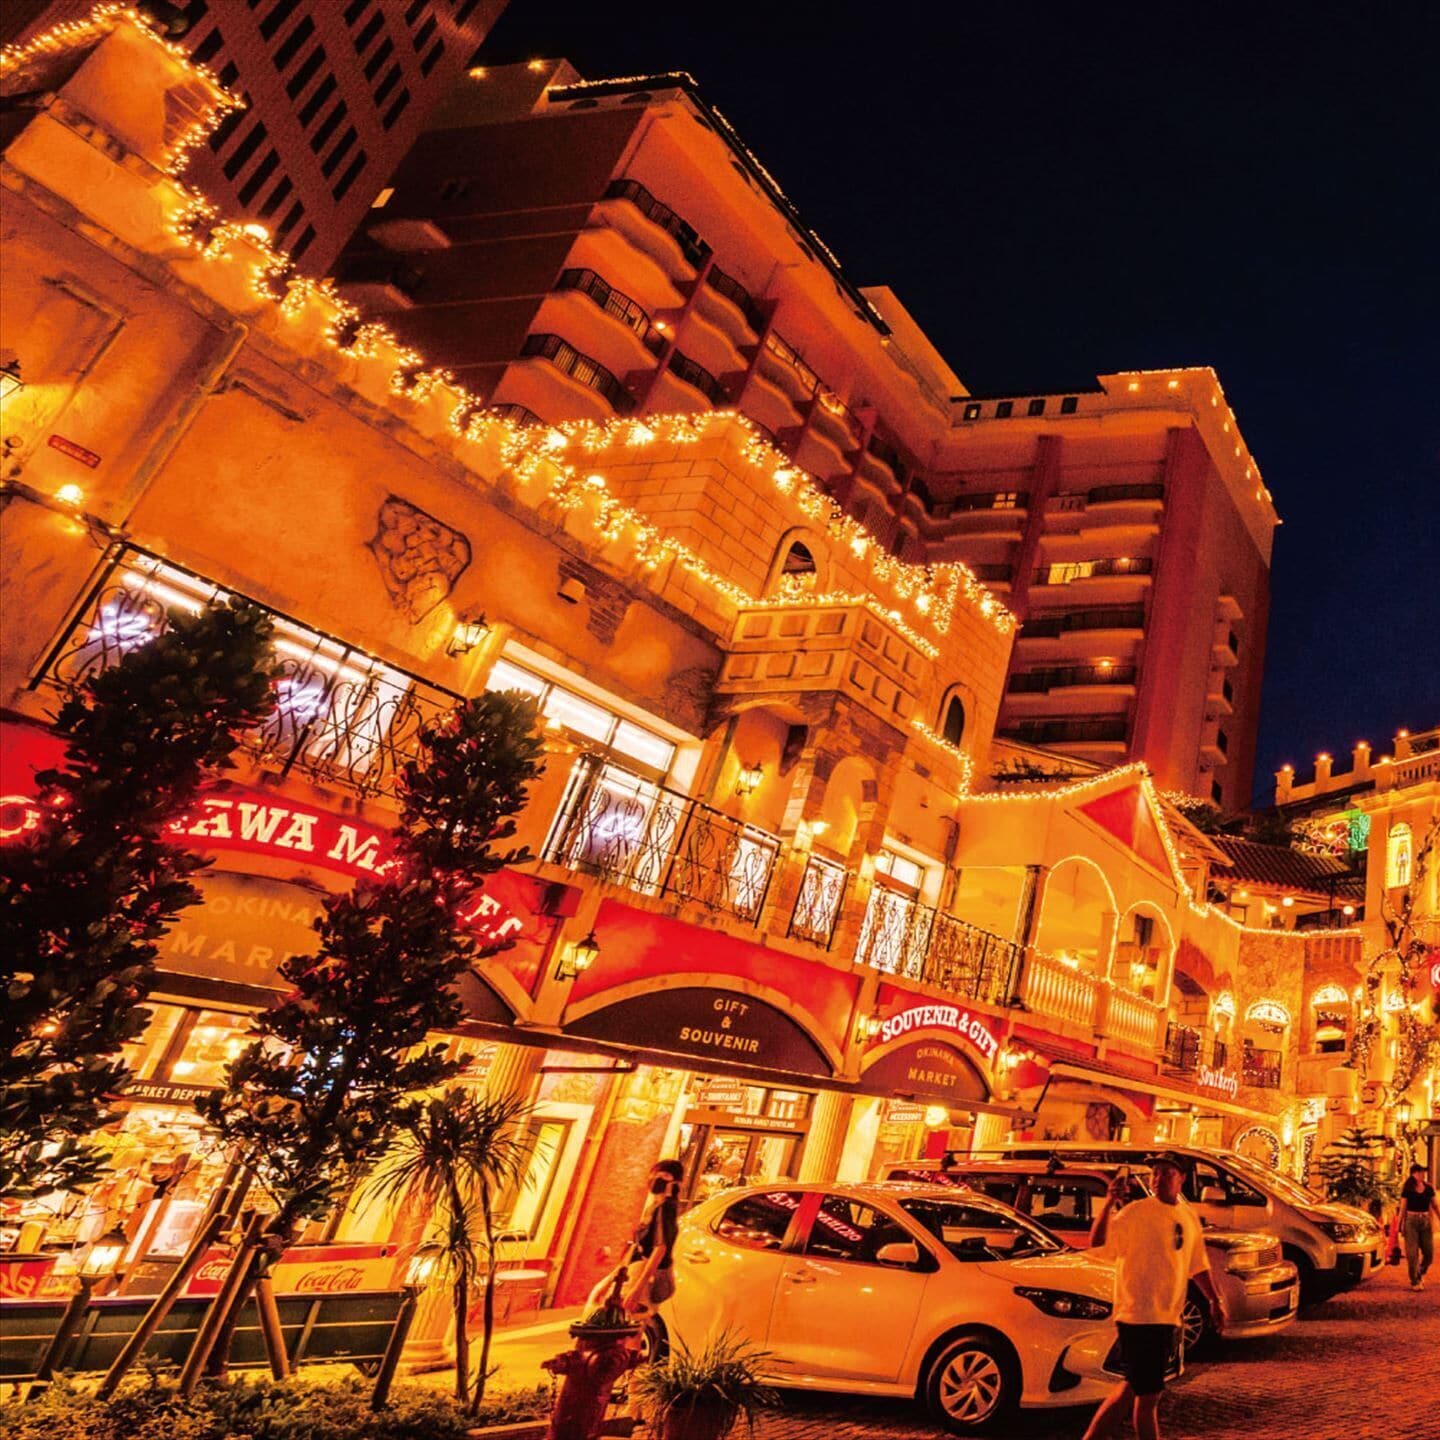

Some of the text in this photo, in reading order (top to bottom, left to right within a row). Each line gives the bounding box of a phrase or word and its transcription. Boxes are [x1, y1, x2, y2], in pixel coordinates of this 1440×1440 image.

[713, 999, 749, 1016] GIFT
[721, 1015, 733, 1029] &
[882, 1005, 999, 1060] SOUVENIR & GIFT
[679, 1026, 760, 1053] SOUVENIR
[907, 1067, 957, 1087] MARKET
[1198, 1064, 1238, 1100] Southerly
